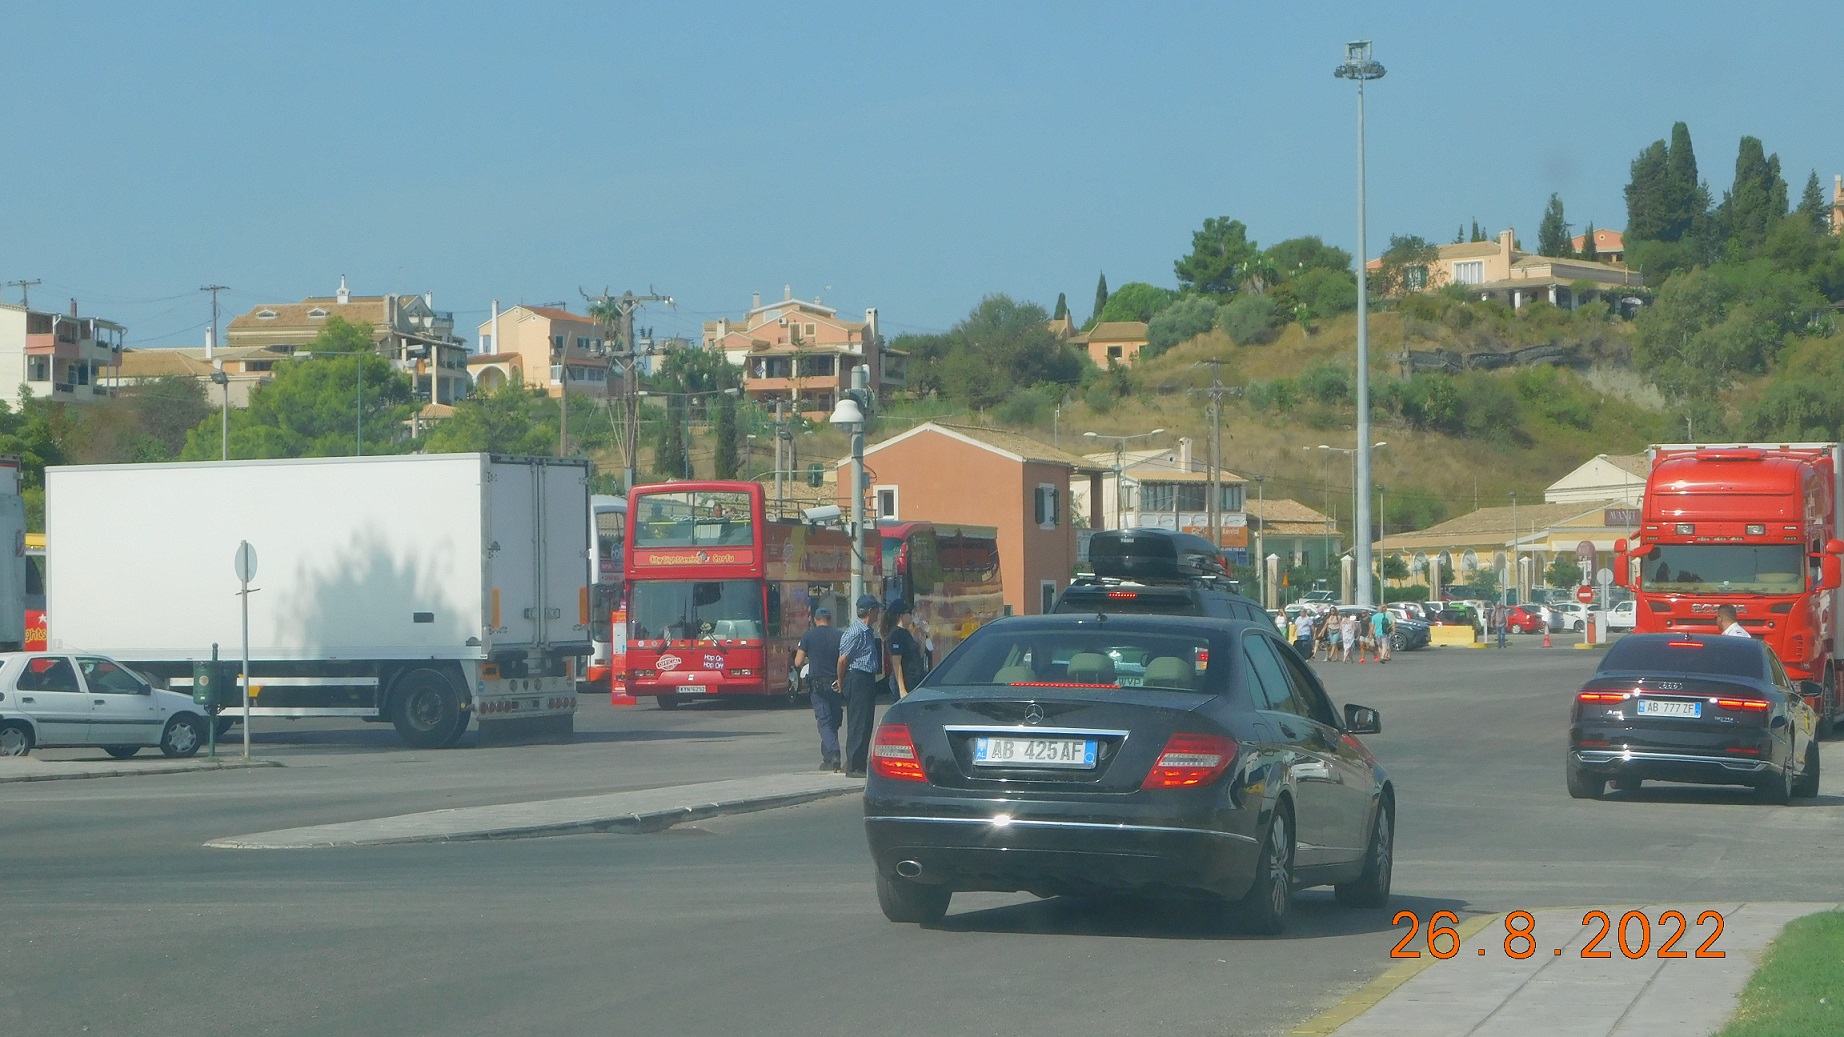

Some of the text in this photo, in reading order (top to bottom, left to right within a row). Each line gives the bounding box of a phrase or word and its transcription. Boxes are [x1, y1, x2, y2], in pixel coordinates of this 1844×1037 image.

[712, 553, 735, 563] Corfu
[1691, 603, 1748, 614] SCAA
[704, 653, 715, 661] Hop
[703, 661, 714, 669] Hop
[1647, 702, 1659, 712] AB
[1663, 703, 1681, 713] 777
[1683, 703, 1694, 714] ZF
[991, 739, 1015, 759] AB
